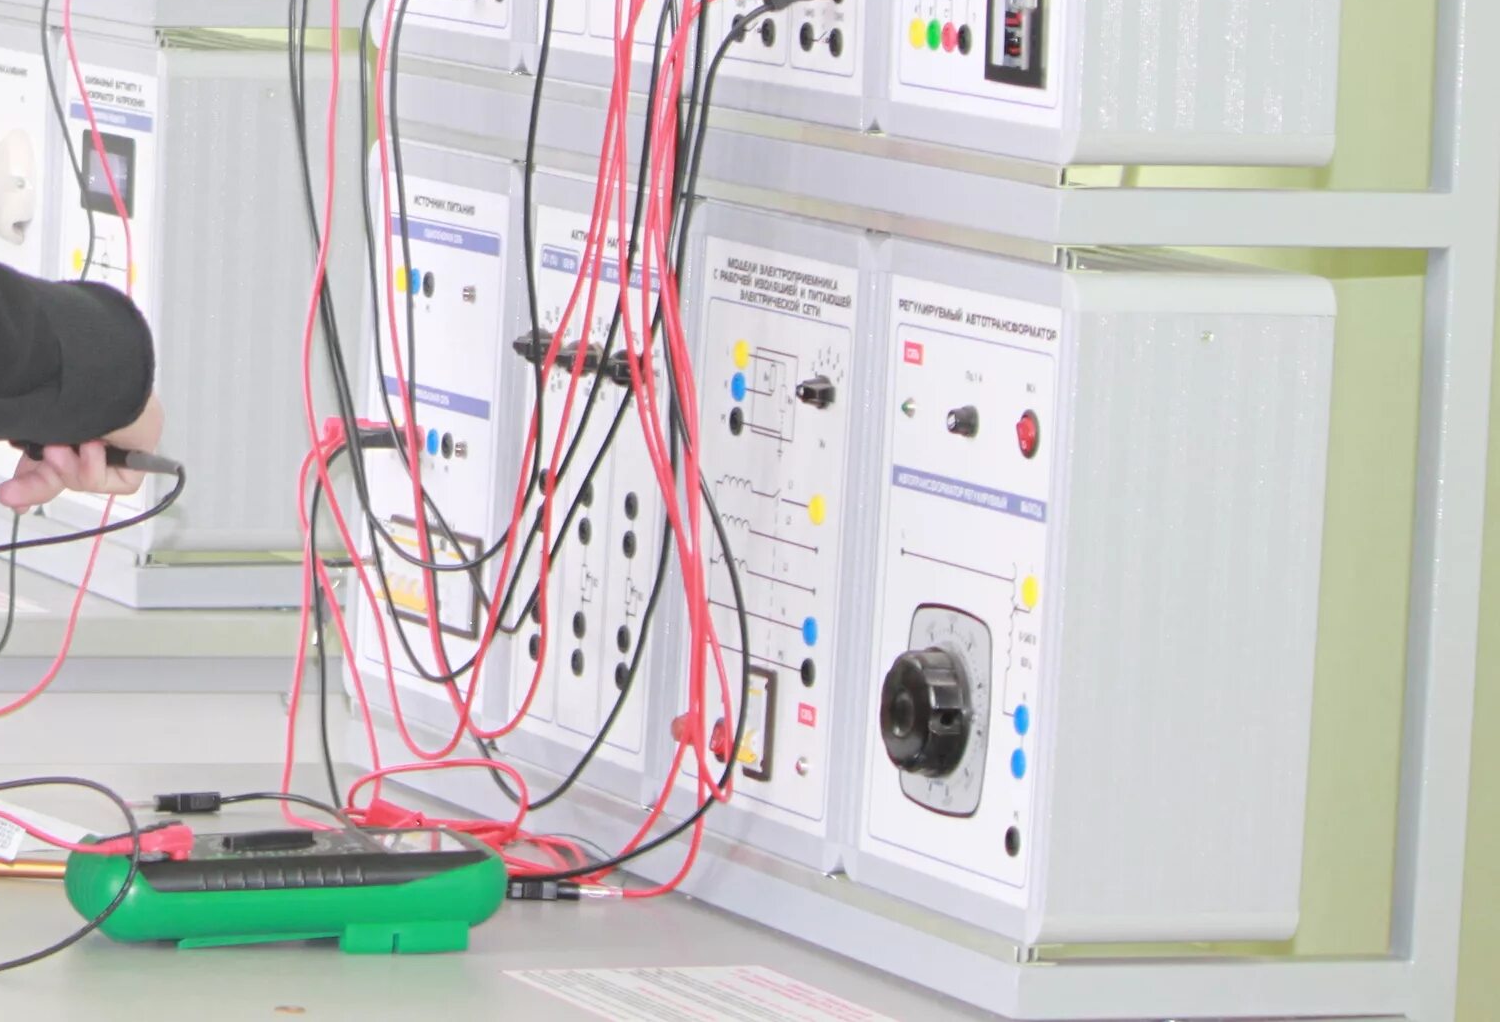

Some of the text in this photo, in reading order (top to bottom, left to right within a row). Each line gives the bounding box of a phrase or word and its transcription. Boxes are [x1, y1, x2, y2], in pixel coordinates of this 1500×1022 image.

[413, 195, 476, 217] ИСТОЧНИК ПИТАНИЯ
[719, 268, 753, 286] РАБОЧЕЙ
[754, 276, 798, 297] ИЗОЛЯЦИЕЙ
[808, 289, 852, 309] ПИТАЮЩЕЙ
[727, 256, 839, 291] МОДЕЛИ ЭЛЕКТРОПРИЕМНИКА
[740, 289, 822, 318] ЭЛЕКТРИЧЕСКОЙ СЕТИ
[898, 297, 1059, 342] РЕГУЛИРУЕМЫЙ АВТОТРАНСФОРМАТОР
